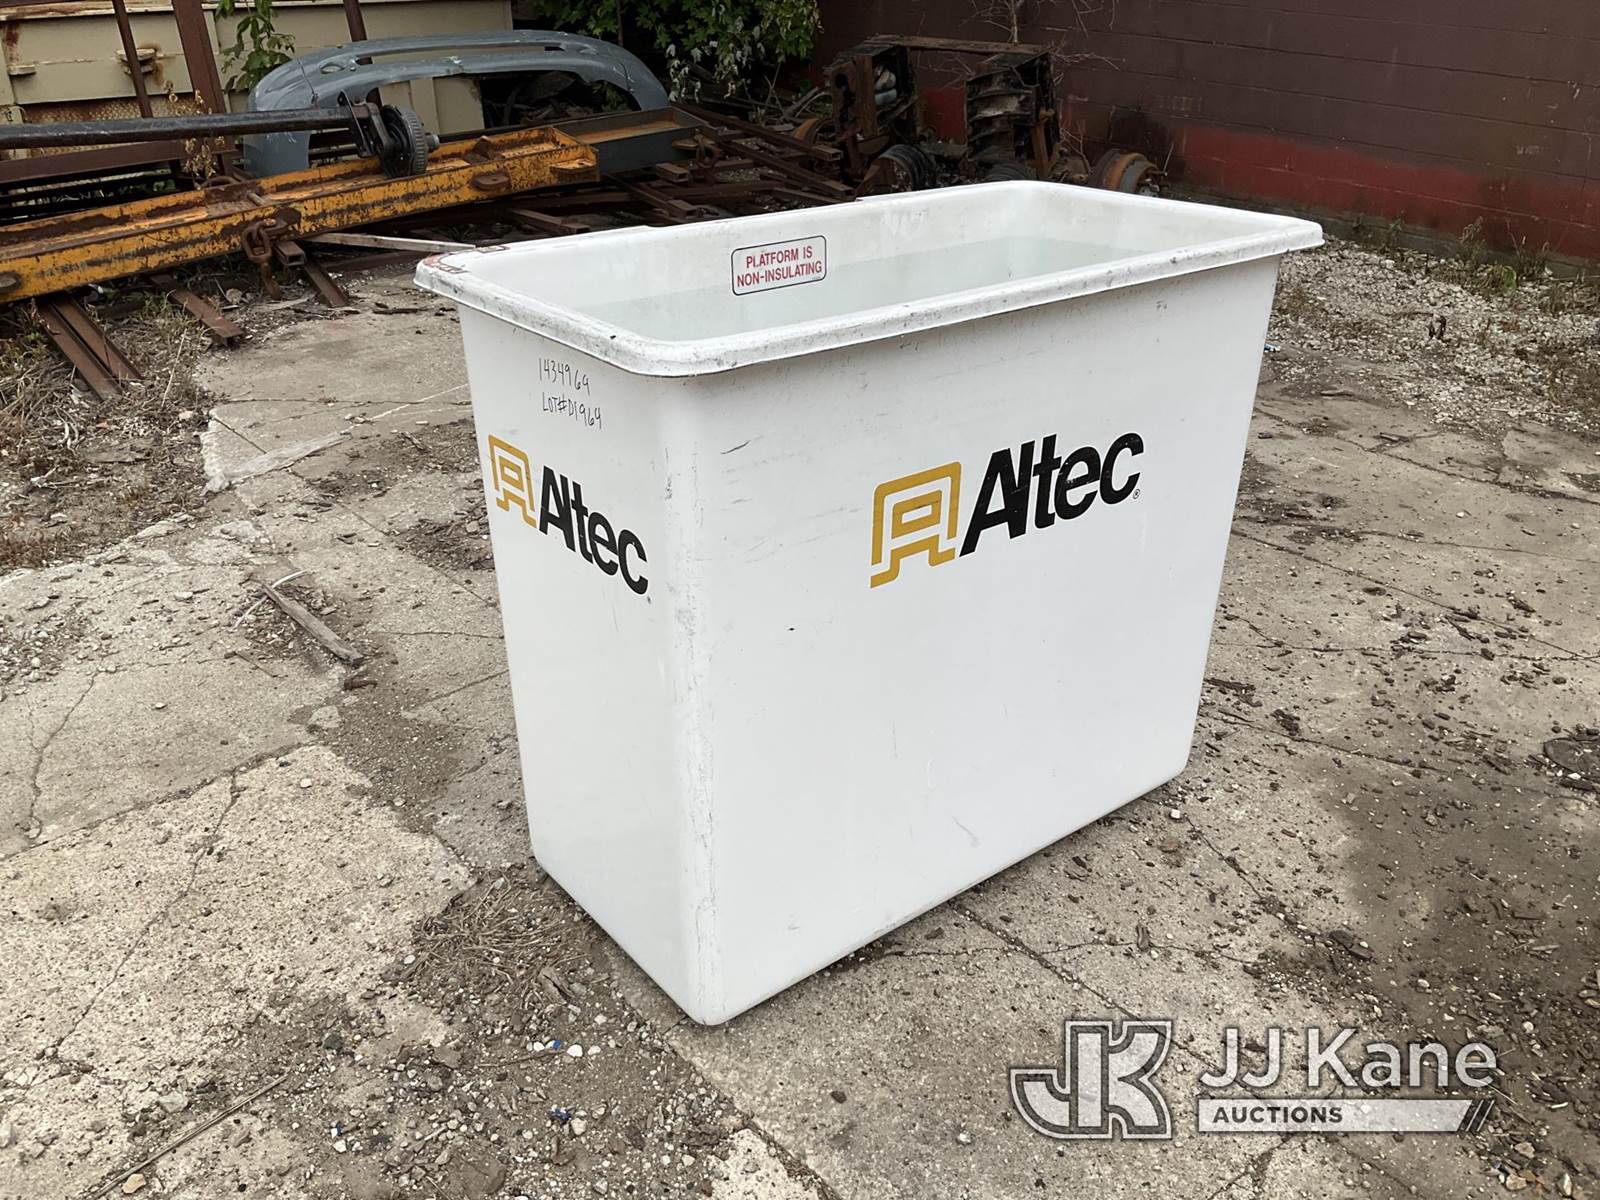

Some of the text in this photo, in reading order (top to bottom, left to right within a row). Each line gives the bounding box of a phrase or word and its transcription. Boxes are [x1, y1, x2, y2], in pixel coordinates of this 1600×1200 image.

[737, 261, 822, 287] NON-INSULATING
[746, 246, 813, 268] PLATFORM IS
[538, 465, 648, 595] Altec
[959, 432, 1144, 557] Altec
